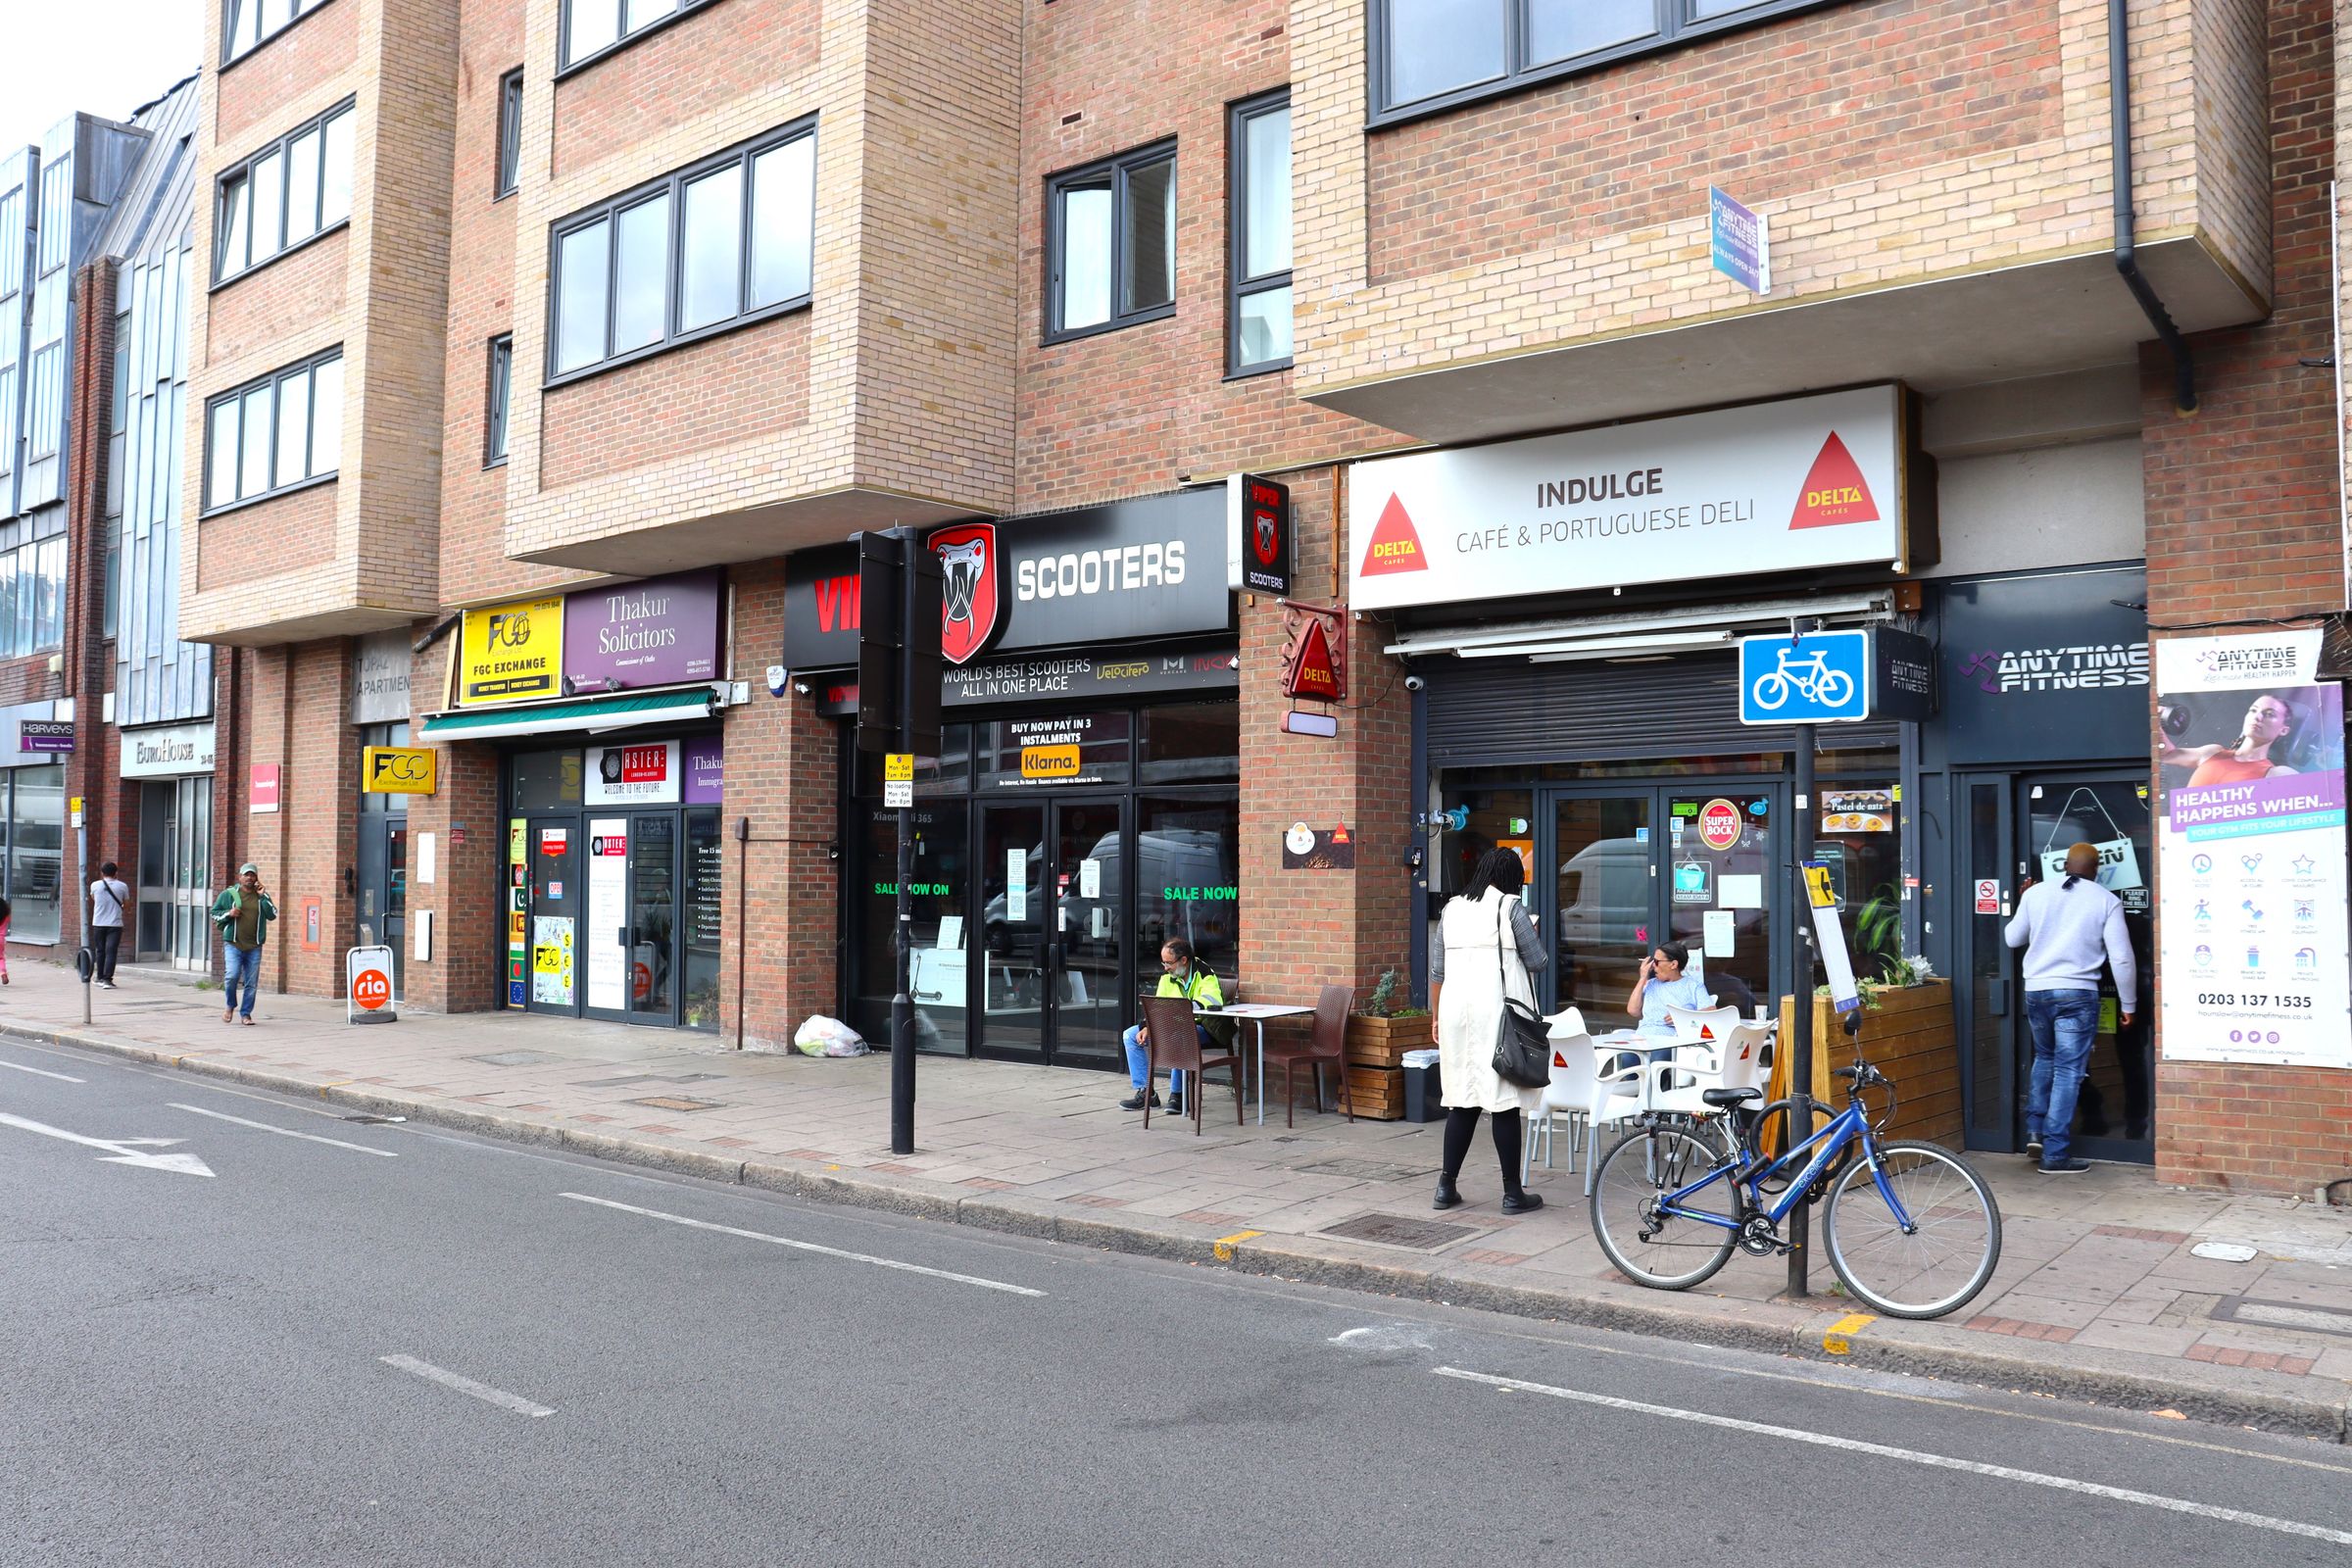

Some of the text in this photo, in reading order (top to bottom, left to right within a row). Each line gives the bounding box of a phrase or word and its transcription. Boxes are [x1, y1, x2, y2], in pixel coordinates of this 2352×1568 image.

[1538, 468, 1663, 509] INDULGE
[1807, 487, 1863, 508] DELTA
[1456, 499, 1753, 553] CAFÉ & PORTUGUESE DELI
[1374, 541, 1416, 558] DELTA
[1017, 540, 1187, 602] SCOOTERS
[1250, 571, 1284, 590] SCOOTERS
[607, 592, 670, 623] Thakur
[599, 623, 675, 655] Solicitors
[1997, 642, 2149, 673] ANYTIME
[2217, 646, 2297, 662] ANYTIME
[358, 658, 389, 673] TOPAZ
[473, 658, 547, 676] FGC EXCHANGE
[943, 658, 1091, 683] WORLD'S BEST SCOOTERS
[1892, 660, 1928, 681] ANYTIME
[2219, 658, 2297, 671] FITNESS
[1303, 666, 1332, 683] DELTA
[2001, 666, 2150, 693] FITNESS
[961, 676, 1068, 698] ALL IN ONE PLACE
[1892, 676, 1929, 694] FITNESS
[1011, 718, 1092, 733] BUY NOW PAY IN 3
[1020, 732, 1081, 746] INSTALMENTS
[374, 753, 428, 781] FGC
[1832, 802, 1854, 811] Pastel
[1856, 802, 1866, 810] de
[2177, 786, 2255, 808] HEALTHY
[917, 814, 932, 823] 365
[1705, 815, 1735, 826] SUPER
[2177, 802, 2257, 823] HAPPENS
[2288, 813, 2336, 827] LIFESTYLE
[1706, 825, 1734, 836] BOCK
[2052, 847, 2125, 872] OEN
[910, 883, 930, 895] OW
[933, 884, 950, 895] ON
[1163, 887, 1238, 900] SALE NOW
[358, 974, 386, 996] ria
[2198, 993, 2312, 1008] 0203 137 1535
[1798, 1159, 1823, 1189] excelle
